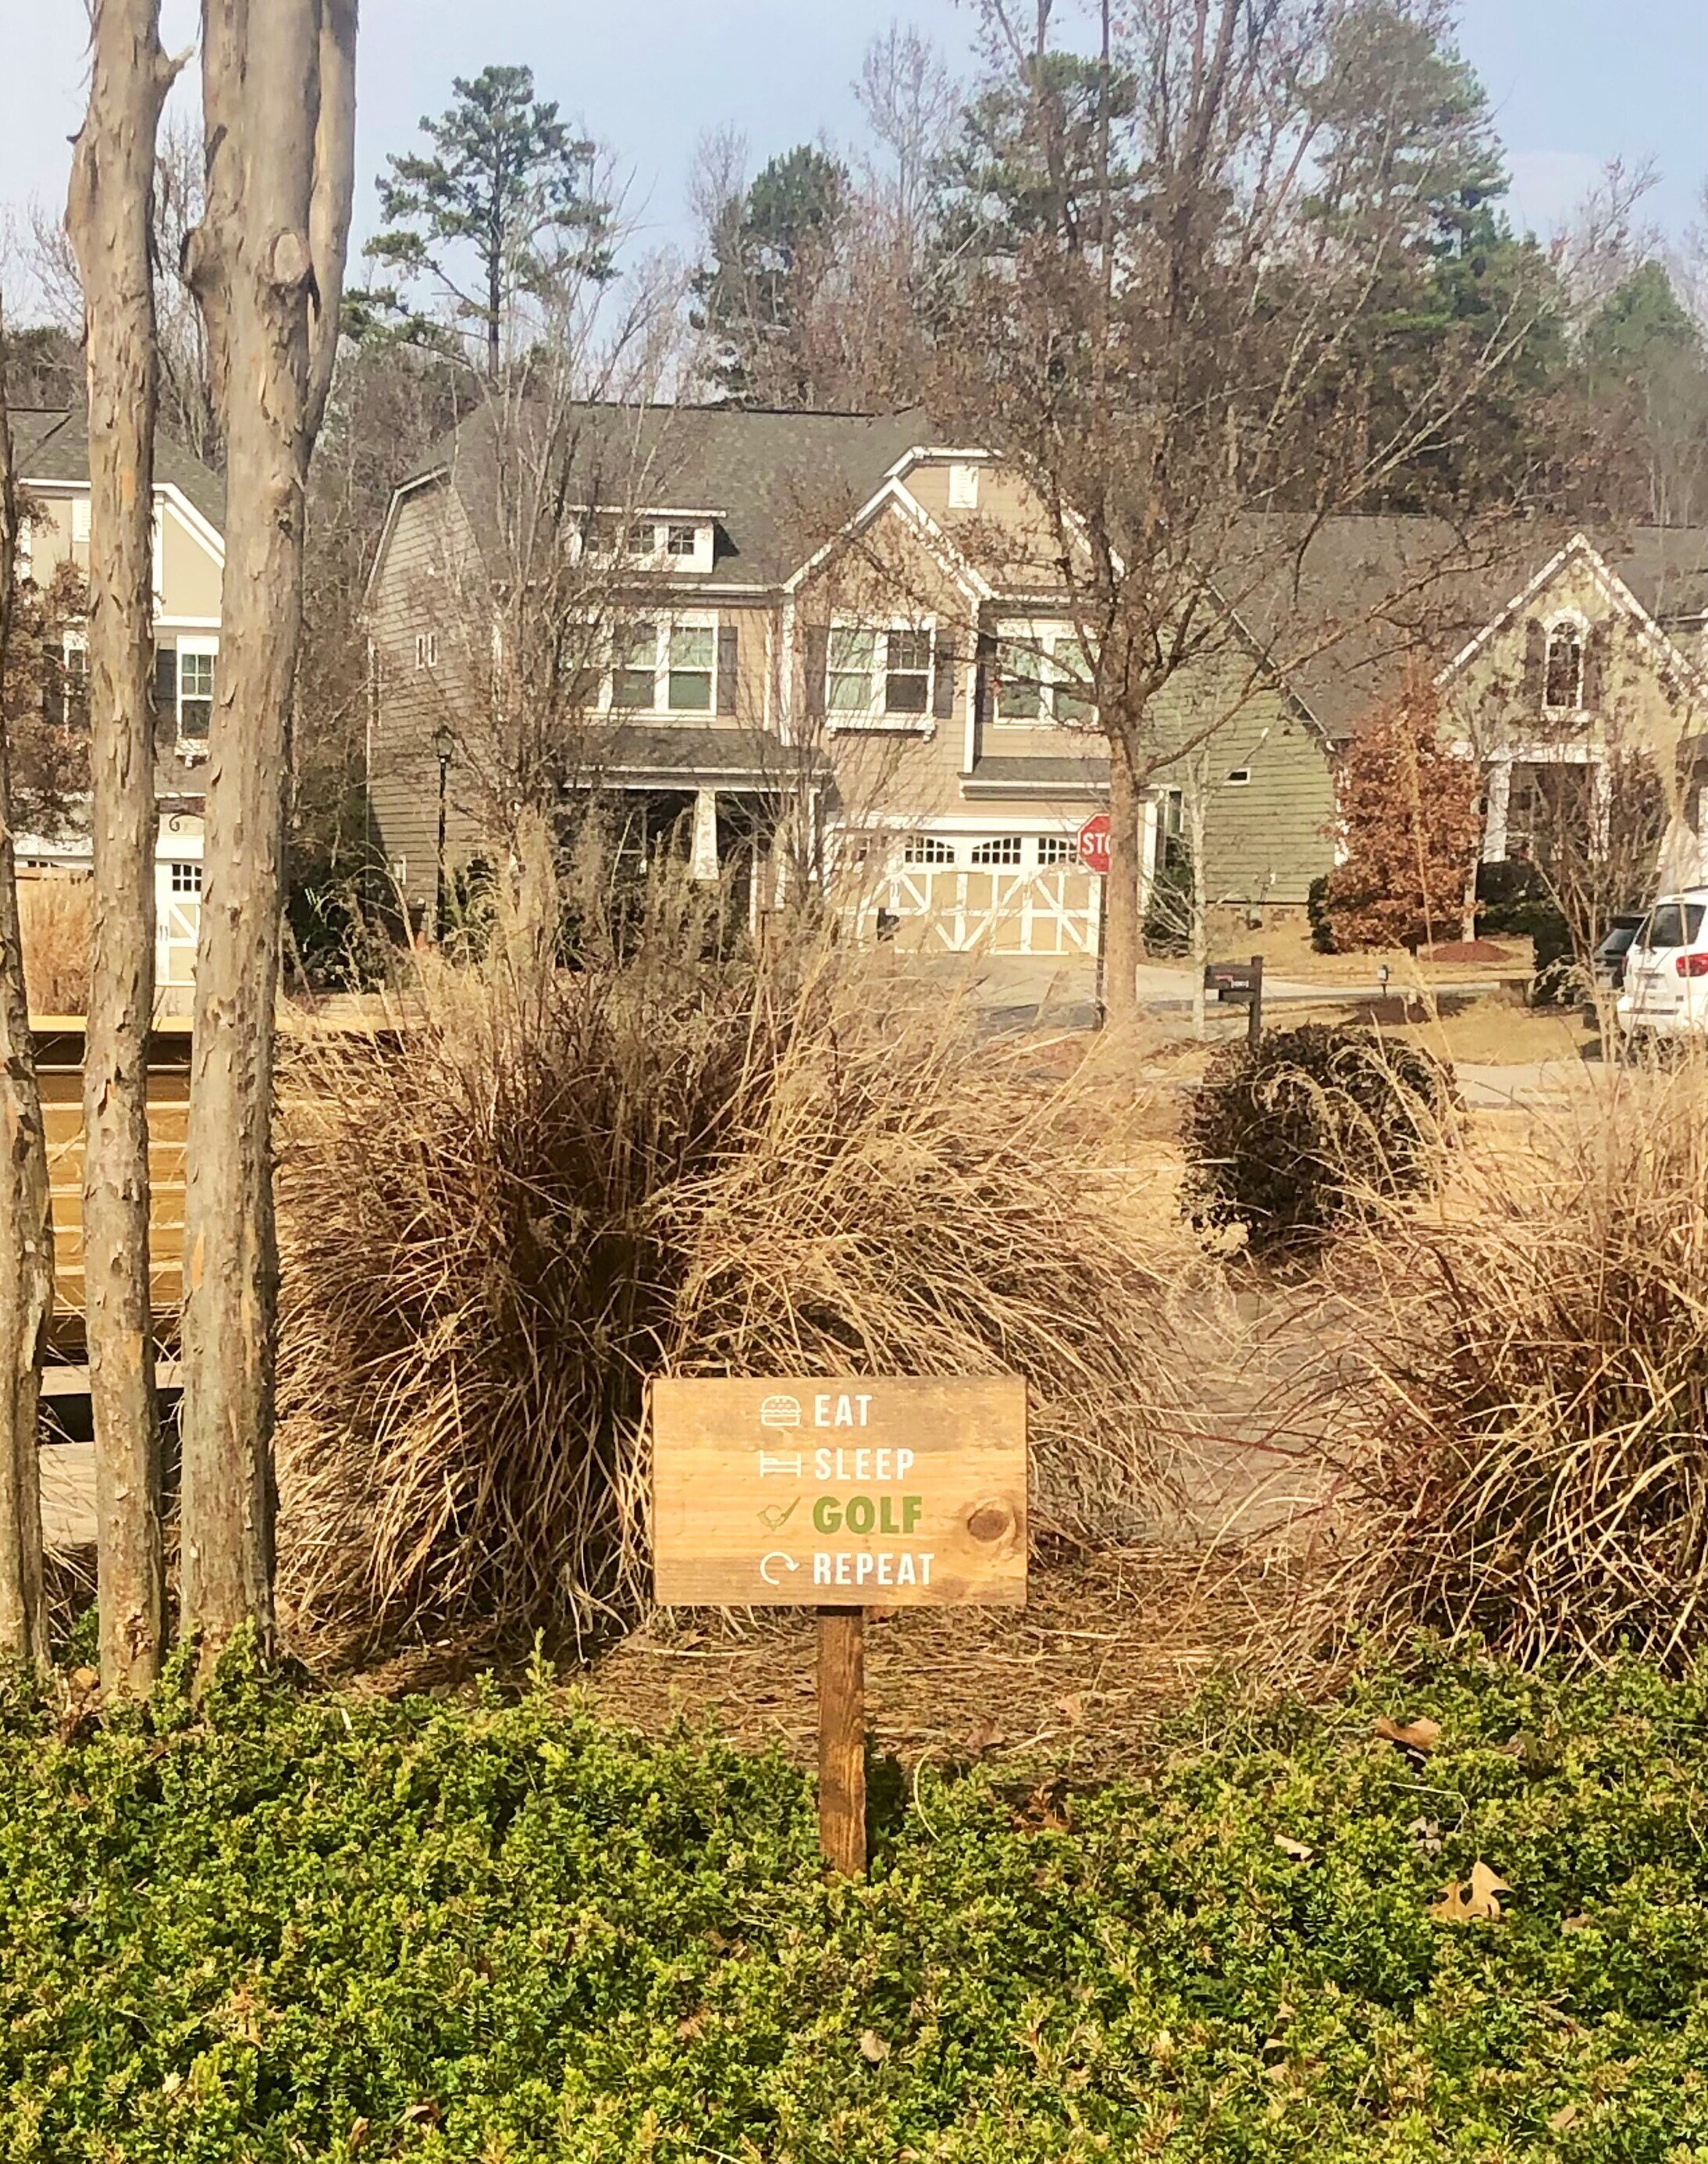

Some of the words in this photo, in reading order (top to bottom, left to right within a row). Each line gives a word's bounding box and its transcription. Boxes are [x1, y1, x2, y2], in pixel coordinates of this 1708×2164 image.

[1081, 832, 1111, 855] ST
[814, 1394, 873, 1426] EAT
[815, 1448, 914, 1480] SLEEP
[813, 1496, 922, 1534] GOLF
[813, 1554, 935, 1586] REPEAT
